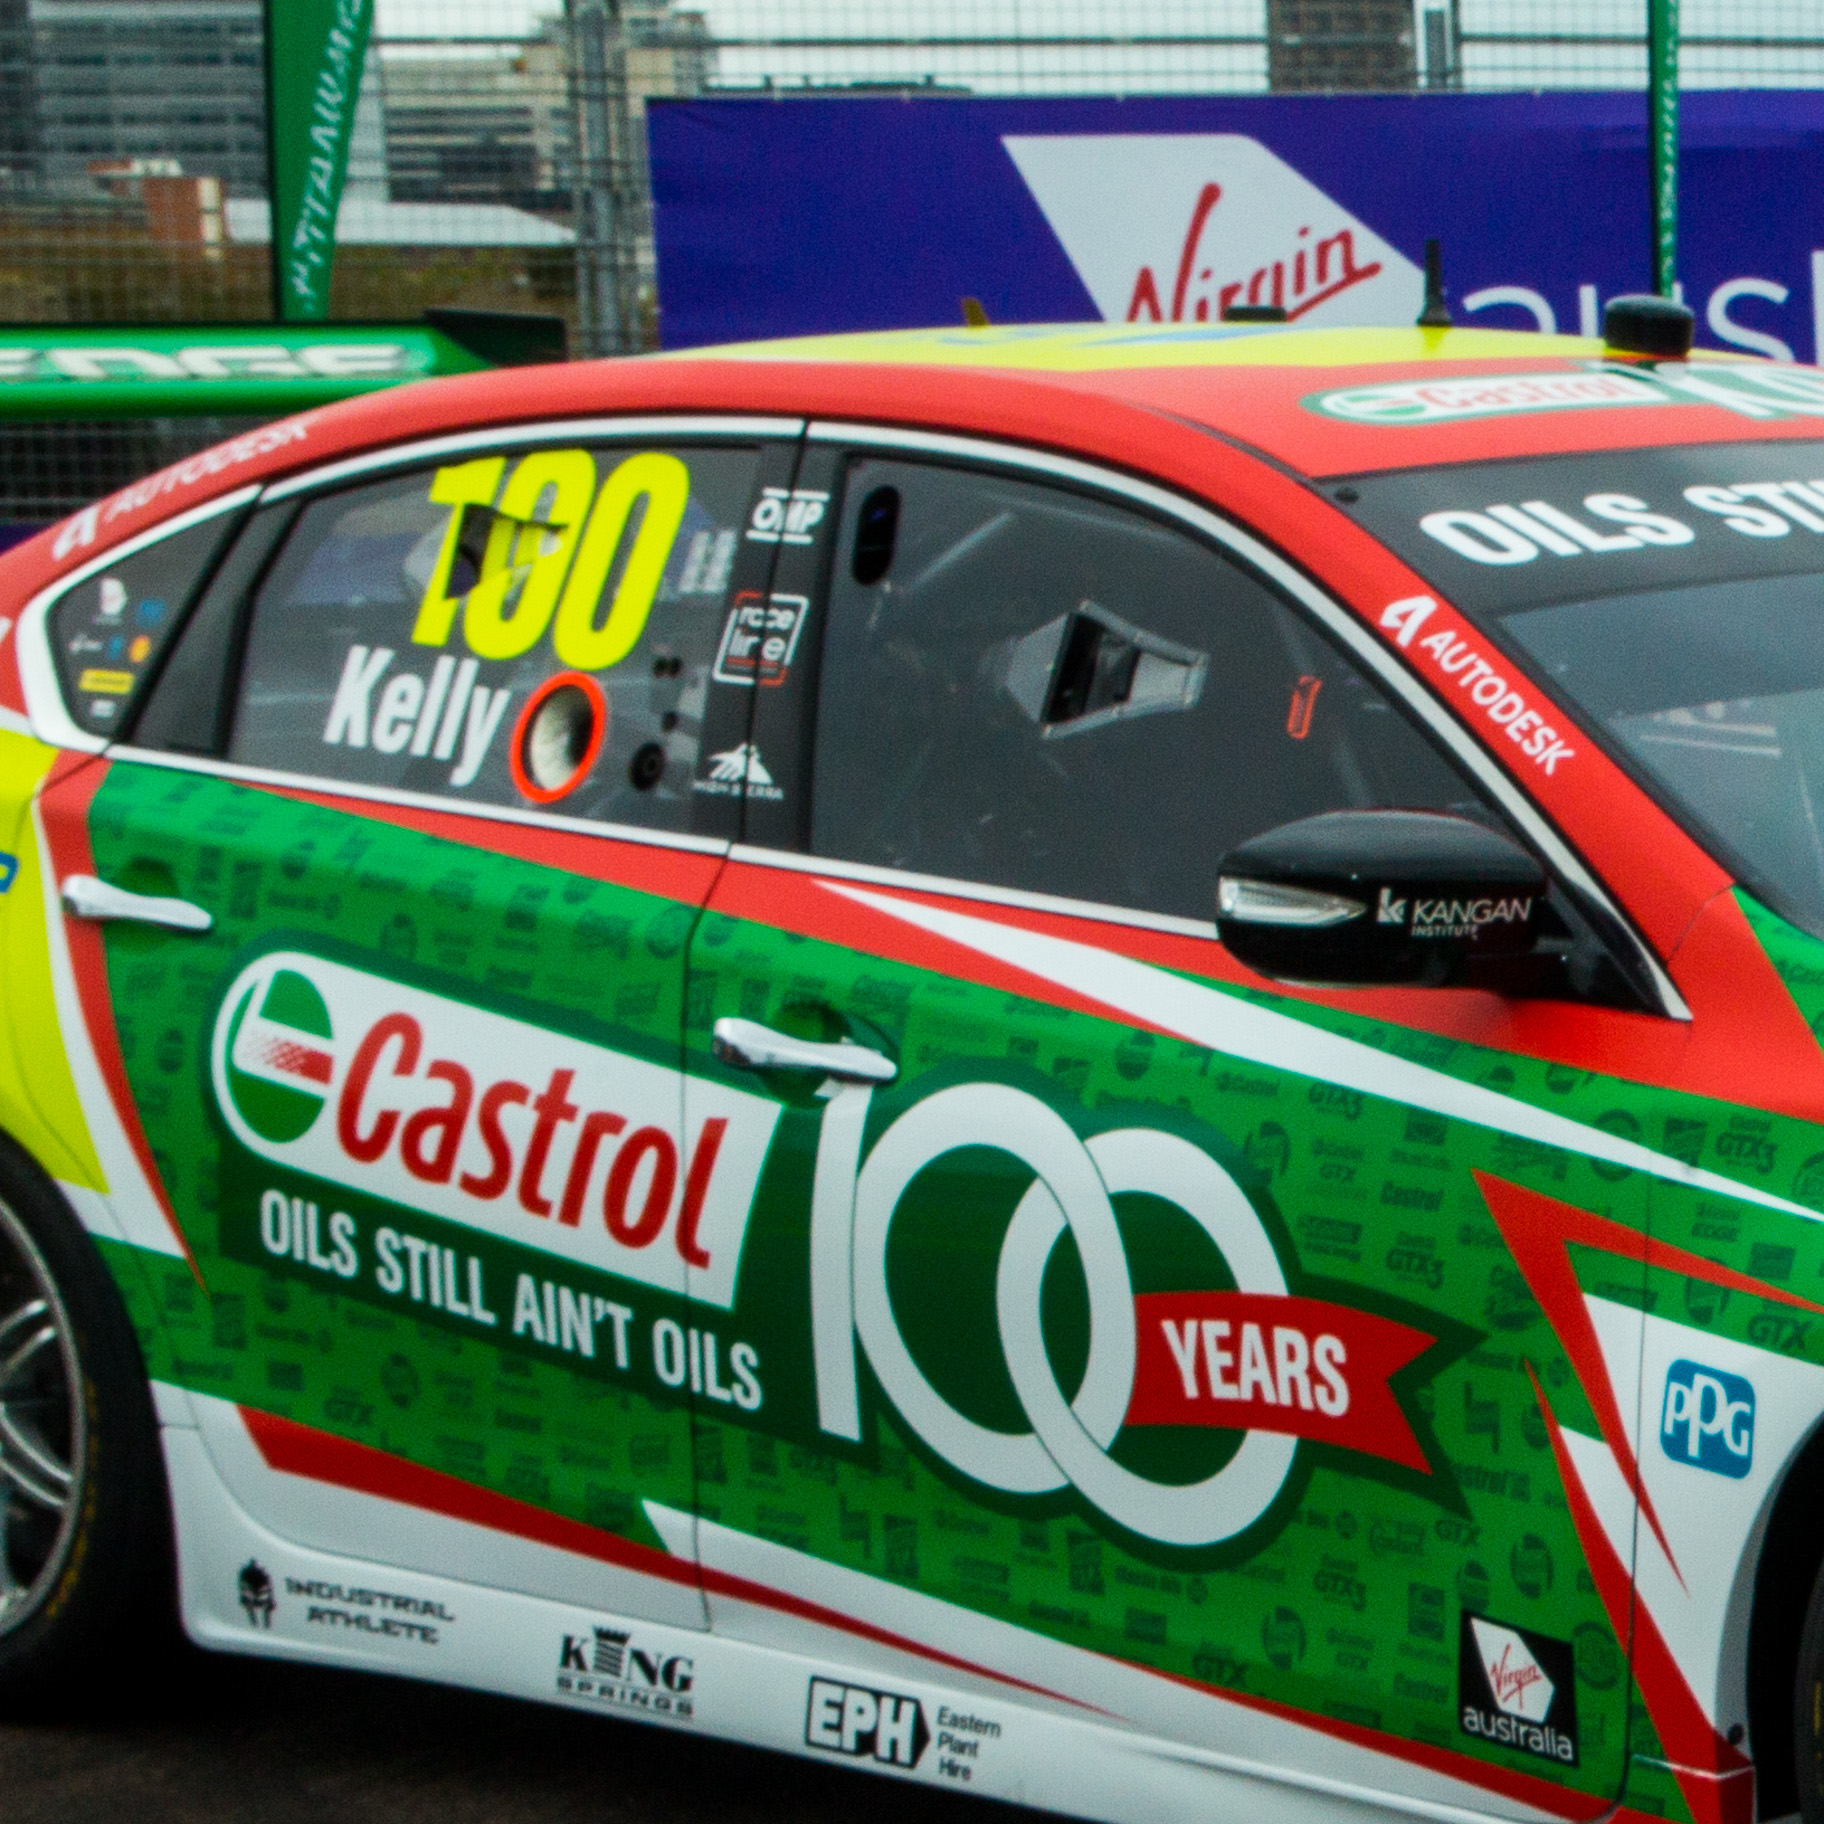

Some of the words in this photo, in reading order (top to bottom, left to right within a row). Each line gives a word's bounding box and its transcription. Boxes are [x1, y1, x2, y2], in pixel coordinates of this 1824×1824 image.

[1419, 494, 1696, 566] OILS
[323, 645, 514, 788] Kelly
[1421, 631, 1576, 776] AUTODESK
[1411, 898, 1532, 923] KANGAN
[1411, 924, 1478, 941] INSTITUTE
[337, 1012, 729, 1270] Castrol
[260, 1188, 360, 1279] OILS
[375, 1224, 497, 1327] STILL
[513, 1275, 632, 1370] AIN'T
[653, 1317, 762, 1411] OILS
[811, 1075, 1301, 1546] 100
[1161, 1319, 1350, 1417] YEARS
[286, 1577, 457, 1622] INDUSTRIAL
[307, 1606, 441, 1644] ATHLETE
[555, 1675, 695, 1717] SPRINGS
[1490, 1642, 1548, 1710] Virgin
[812, 1679, 918, 1767] EPH
[937, 1706, 1002, 1737] Eastern
[937, 1731, 981, 1760] Plant
[1463, 1703, 1574, 1762] australia
[938, 1755, 972, 1783] Hire
